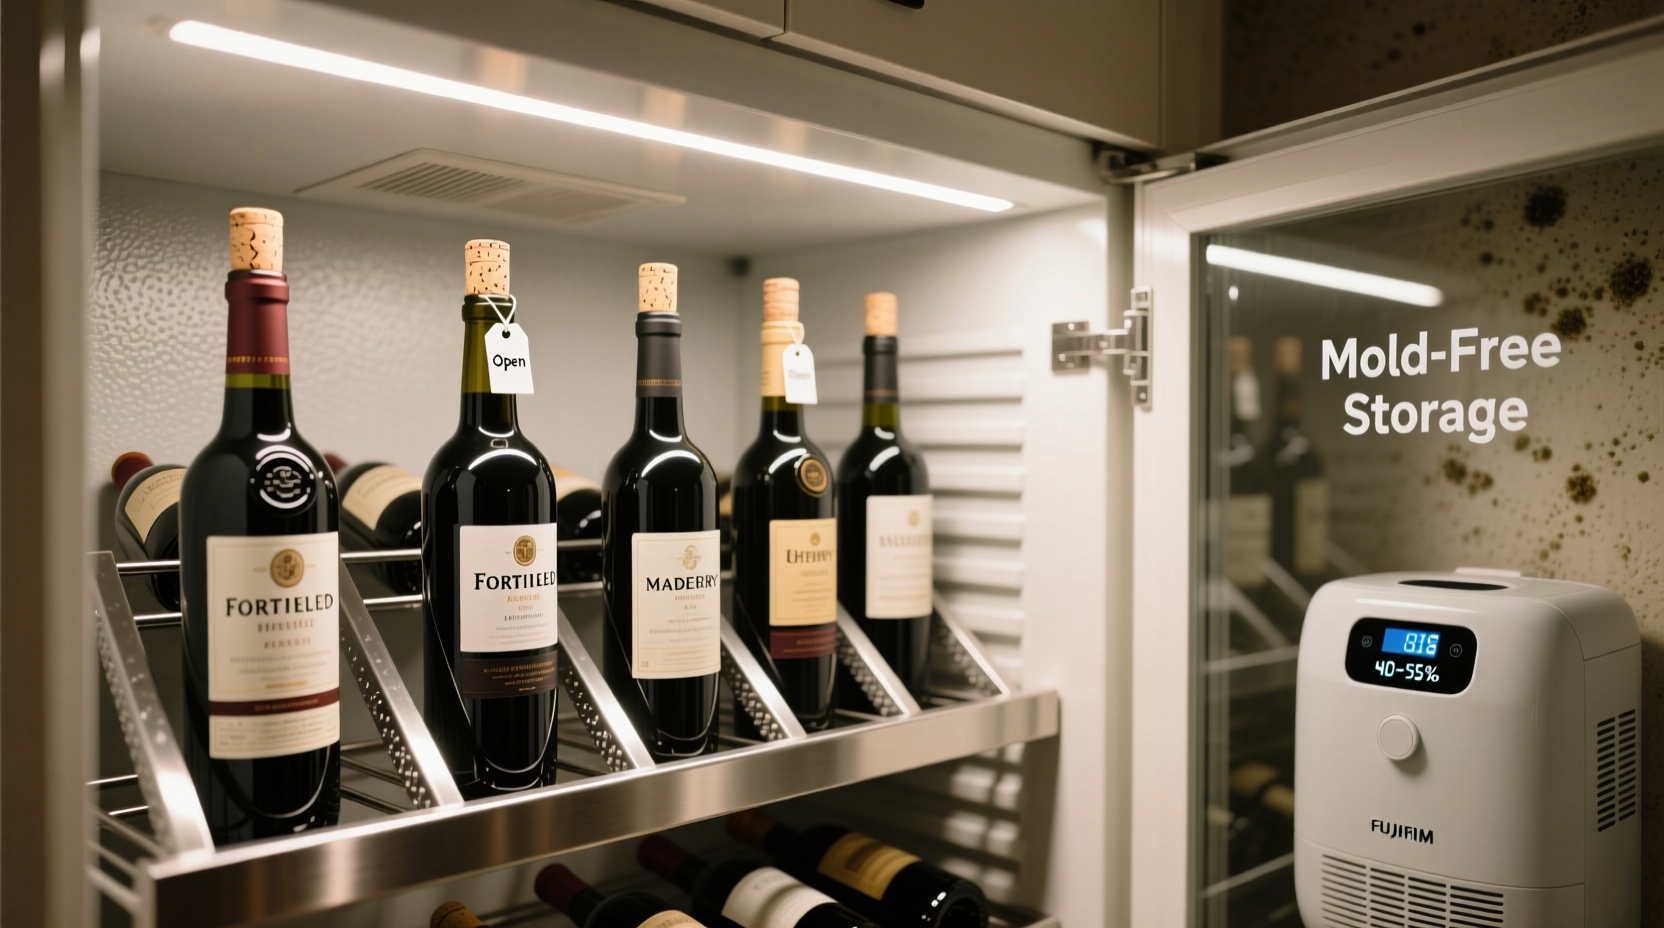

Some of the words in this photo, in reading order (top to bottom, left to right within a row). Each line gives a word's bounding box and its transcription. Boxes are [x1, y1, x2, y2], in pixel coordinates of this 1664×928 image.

[492, 354, 526, 372] Open
[1321, 327, 1562, 380] Mold-Free
[1343, 392, 1529, 444] Storage
[1375, 660, 1440, 683] 40-55%
